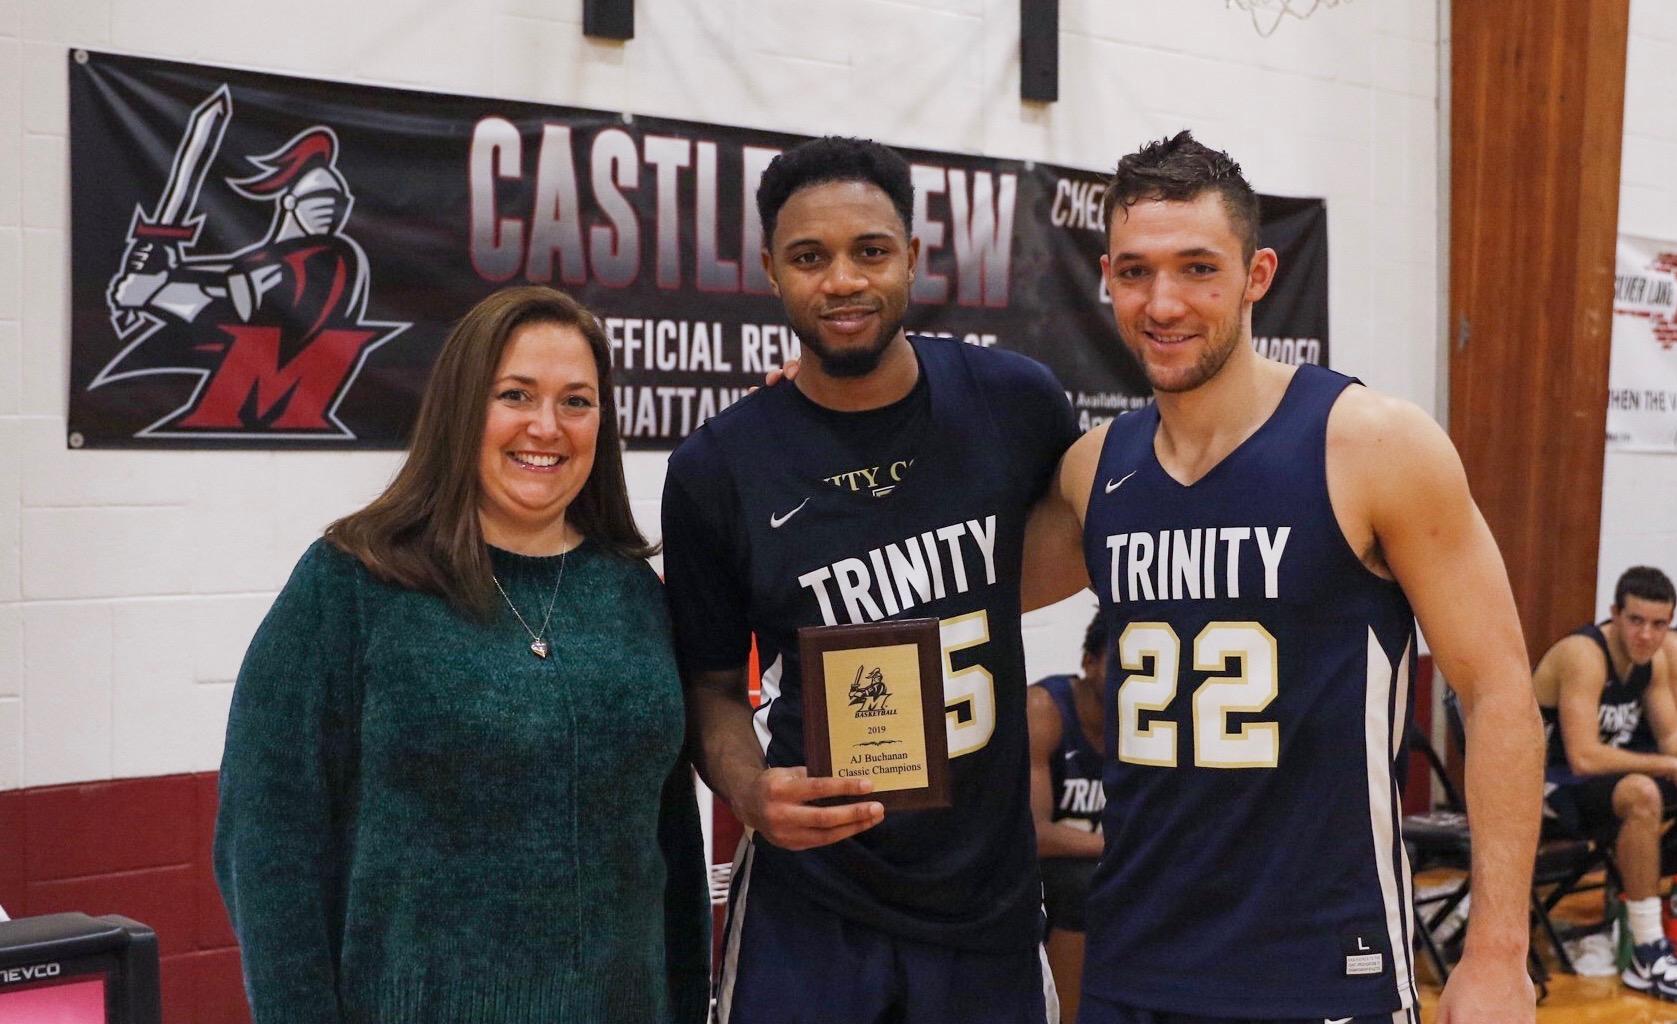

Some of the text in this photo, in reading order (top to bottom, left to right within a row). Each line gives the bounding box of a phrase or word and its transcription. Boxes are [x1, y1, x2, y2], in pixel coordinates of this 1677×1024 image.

[597, 317, 732, 373] FFICIAL
[1609, 390, 1639, 410] HEN
[798, 515, 997, 626] TRINITY
[1106, 526, 1292, 603] TRINITY
[1117, 621, 1280, 769] 22
[855, 709, 898, 718] BASKETBALL
[868, 726, 886, 734] 2019
[850, 752, 908, 764] AJ Buchanan
[838, 763, 922, 778] Classic Champions
[1357, 937, 1370, 950] L
